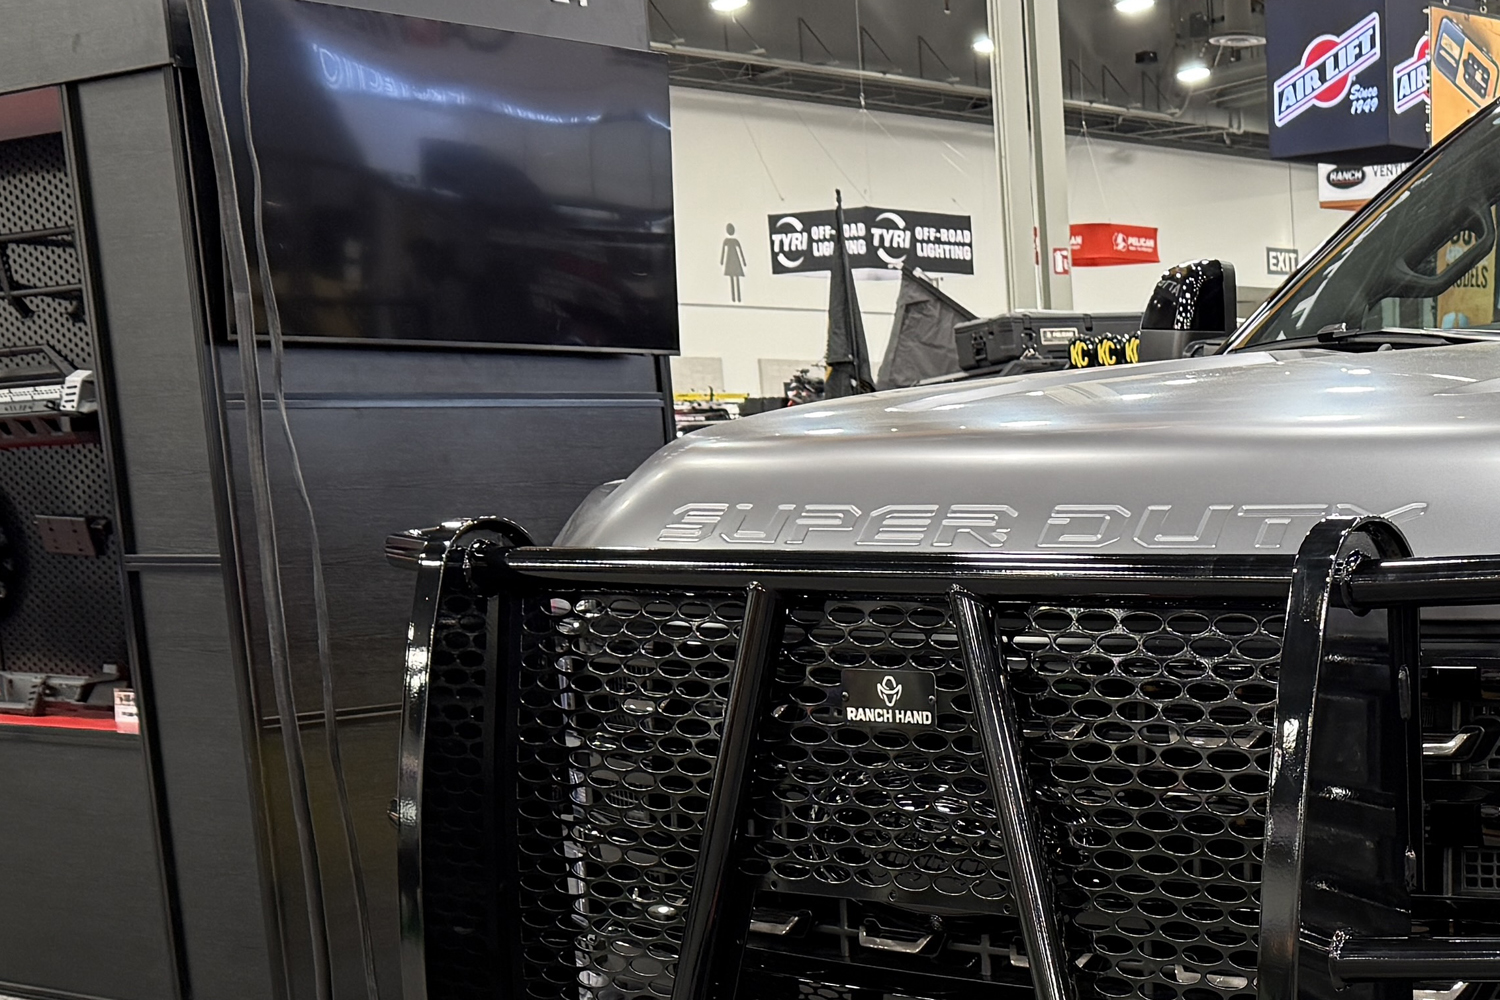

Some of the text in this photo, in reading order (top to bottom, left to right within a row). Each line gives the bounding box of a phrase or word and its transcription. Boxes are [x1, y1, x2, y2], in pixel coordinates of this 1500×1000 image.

[1281, 28, 1373, 112] AIR LIFT
[1399, 63, 1428, 99] AIR
[1349, 84, 1378, 100] Since
[1350, 97, 1378, 115] 1949
[811, 223, 866, 240] OFF-OAD
[871, 228, 911, 248] TYRI
[915, 226, 971, 243] OFF-ROAD
[772, 232, 808, 252] TYRI
[813, 239, 867, 257] LIGING
[916, 243, 972, 260] LIGHTING
[1269, 251, 1297, 272] EXIT
[1070, 340, 1088, 368] KC
[1097, 339, 1116, 366] KC
[657, 502, 1018, 547] SUPER
[846, 707, 932, 725] RANCH HAND
